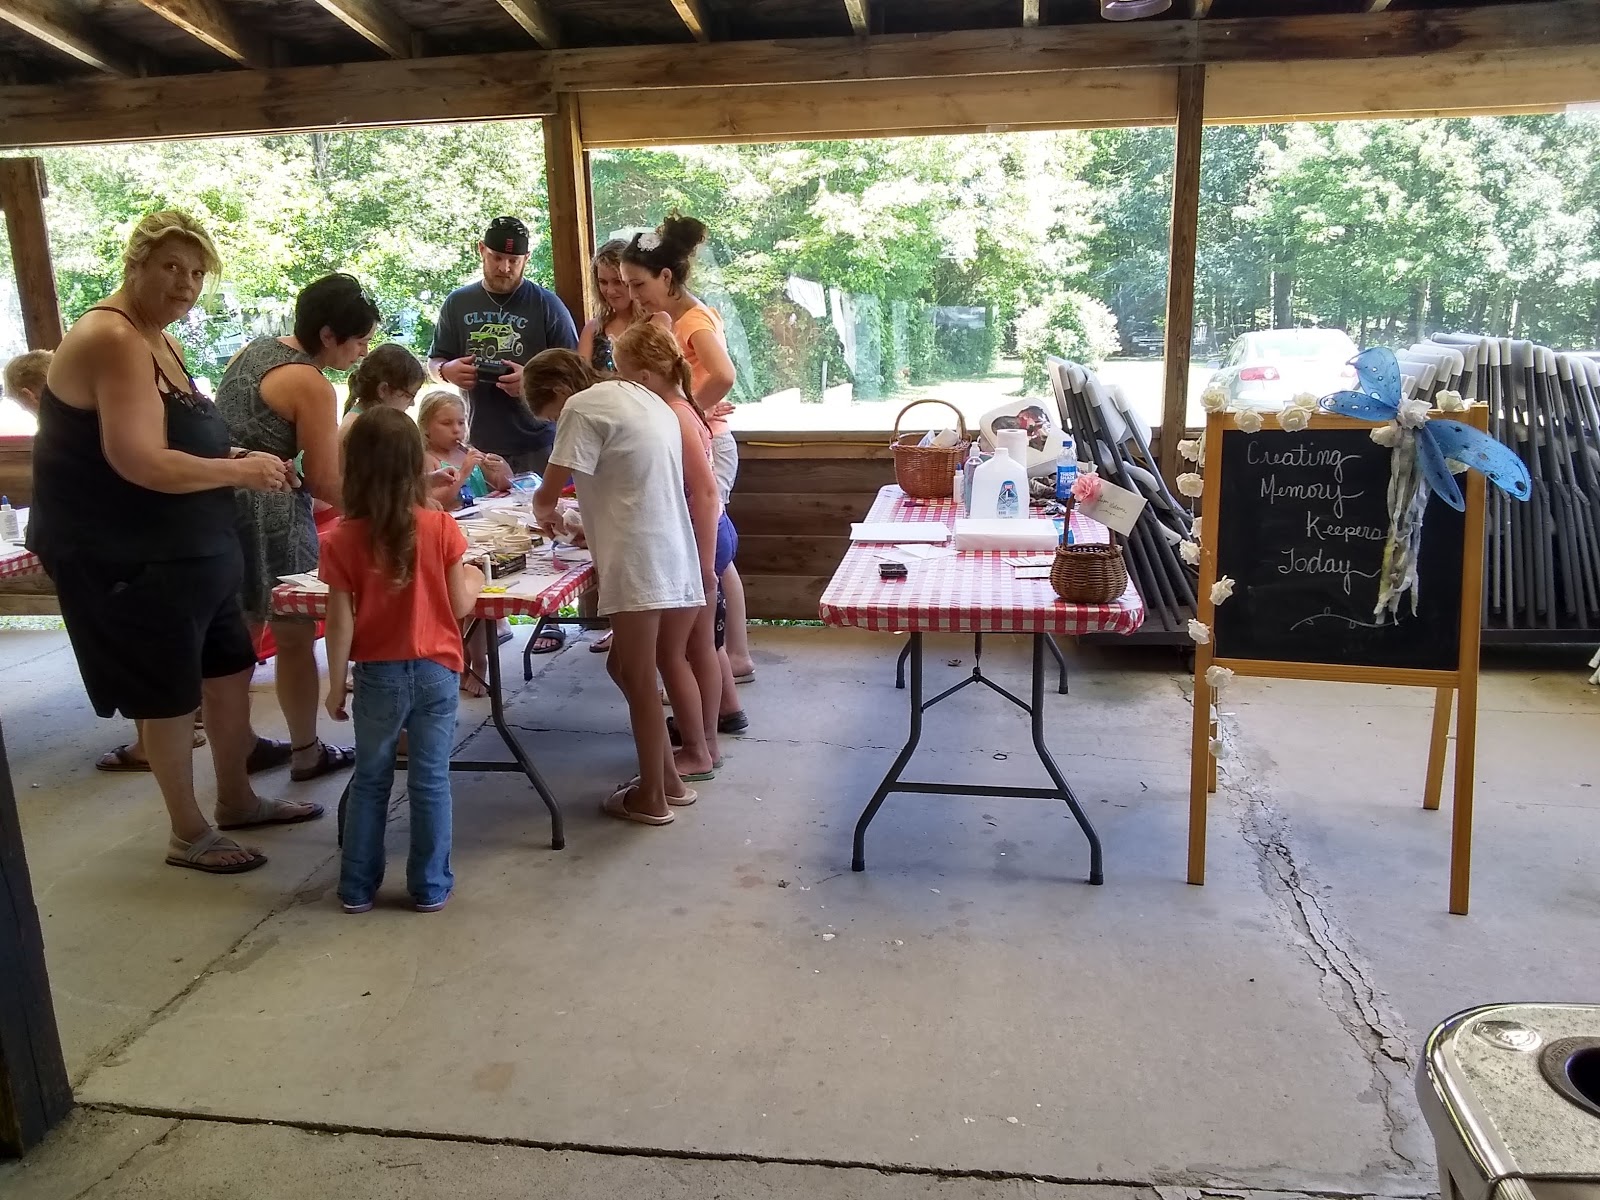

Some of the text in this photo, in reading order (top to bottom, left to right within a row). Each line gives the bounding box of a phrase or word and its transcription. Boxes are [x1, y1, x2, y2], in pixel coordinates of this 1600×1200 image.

[1247, 441, 1362, 482] Creating
[1260, 474, 1364, 518] Memory
[1306, 511, 1388, 542] Keepers
[1277, 548, 1381, 595] Today
